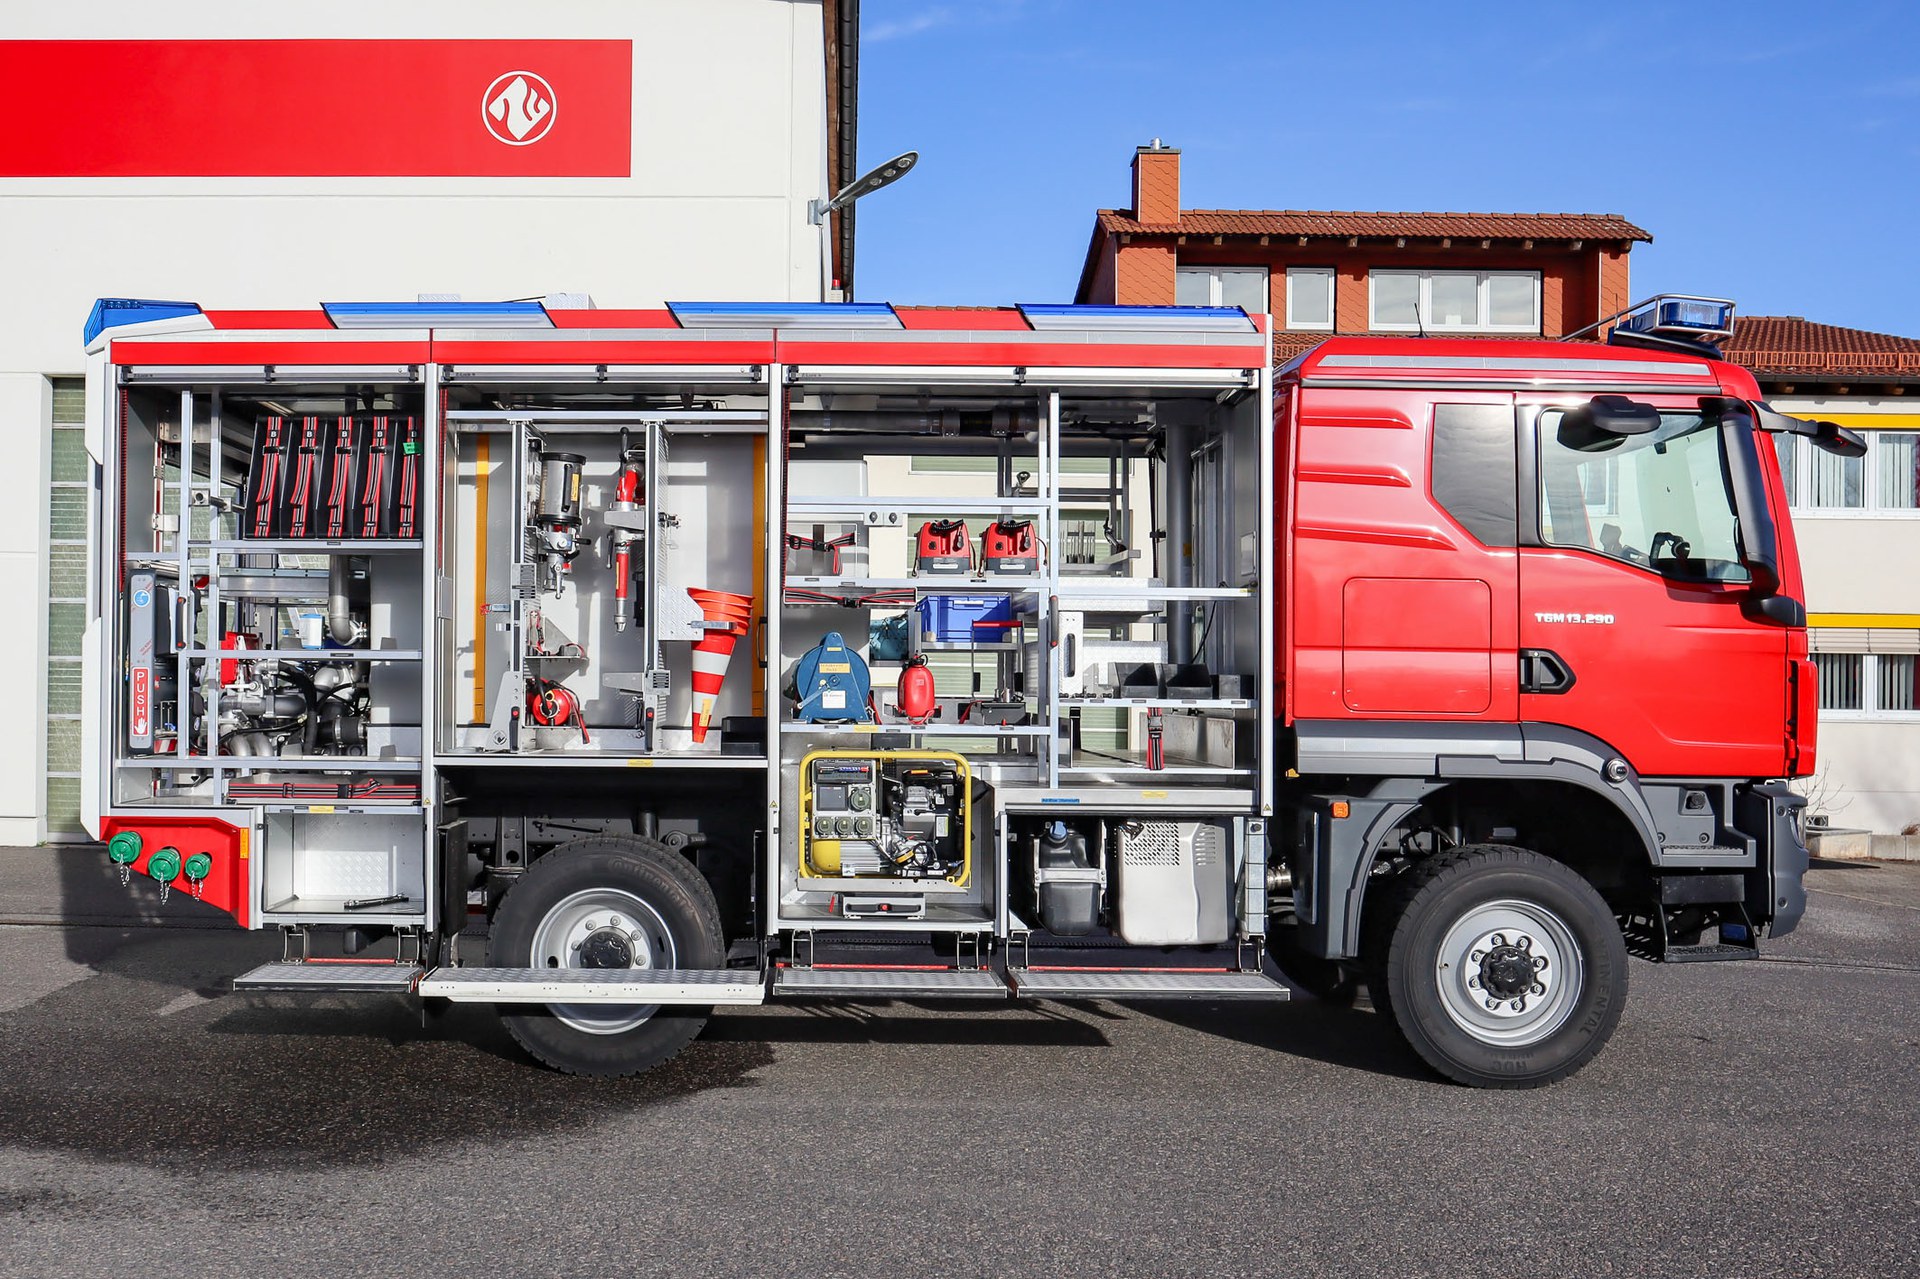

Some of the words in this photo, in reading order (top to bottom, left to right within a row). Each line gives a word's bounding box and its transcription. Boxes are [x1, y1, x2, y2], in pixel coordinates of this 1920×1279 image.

[1534, 612, 1565, 623] TGM
[1566, 613, 1615, 624] 13.290
[136, 671, 145, 716] PUSH
